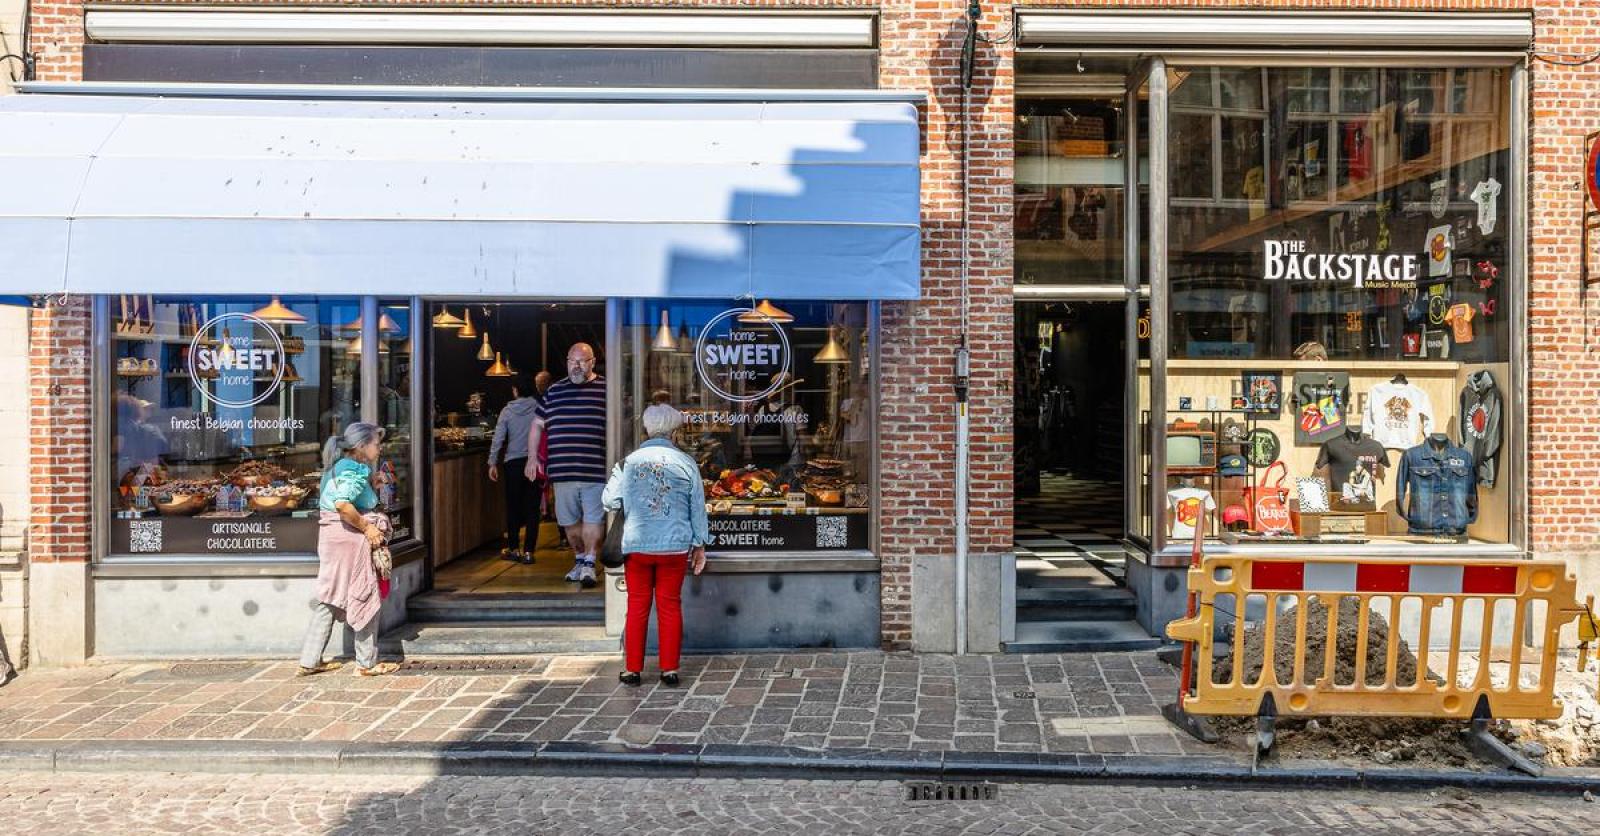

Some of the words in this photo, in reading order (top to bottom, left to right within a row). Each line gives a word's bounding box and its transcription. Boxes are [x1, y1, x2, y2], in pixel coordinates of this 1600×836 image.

[1281, 240, 1306, 256] THE
[1264, 239, 1417, 288] BACKSTAGE
[1364, 280, 1390, 289] Music
[1391, 280, 1417, 289] Merch
[223, 335, 250, 347] home
[728, 328, 758, 341] home
[198, 347, 275, 370] SWEET
[705, 343, 781, 365] SWEET
[223, 374, 250, 386] home
[728, 367, 758, 380] home
[170, 416, 201, 430] finest
[205, 416, 245, 432] Belgian
[247, 416, 305, 430] chocolates
[712, 411, 750, 426] Belgian
[753, 411, 809, 424] chocolates
[211, 522, 273, 535] ARTISANALE
[206, 537, 278, 550] CHOCOLATERIE
[718, 533, 760, 546] SWEET
[761, 536, 786, 546] home
